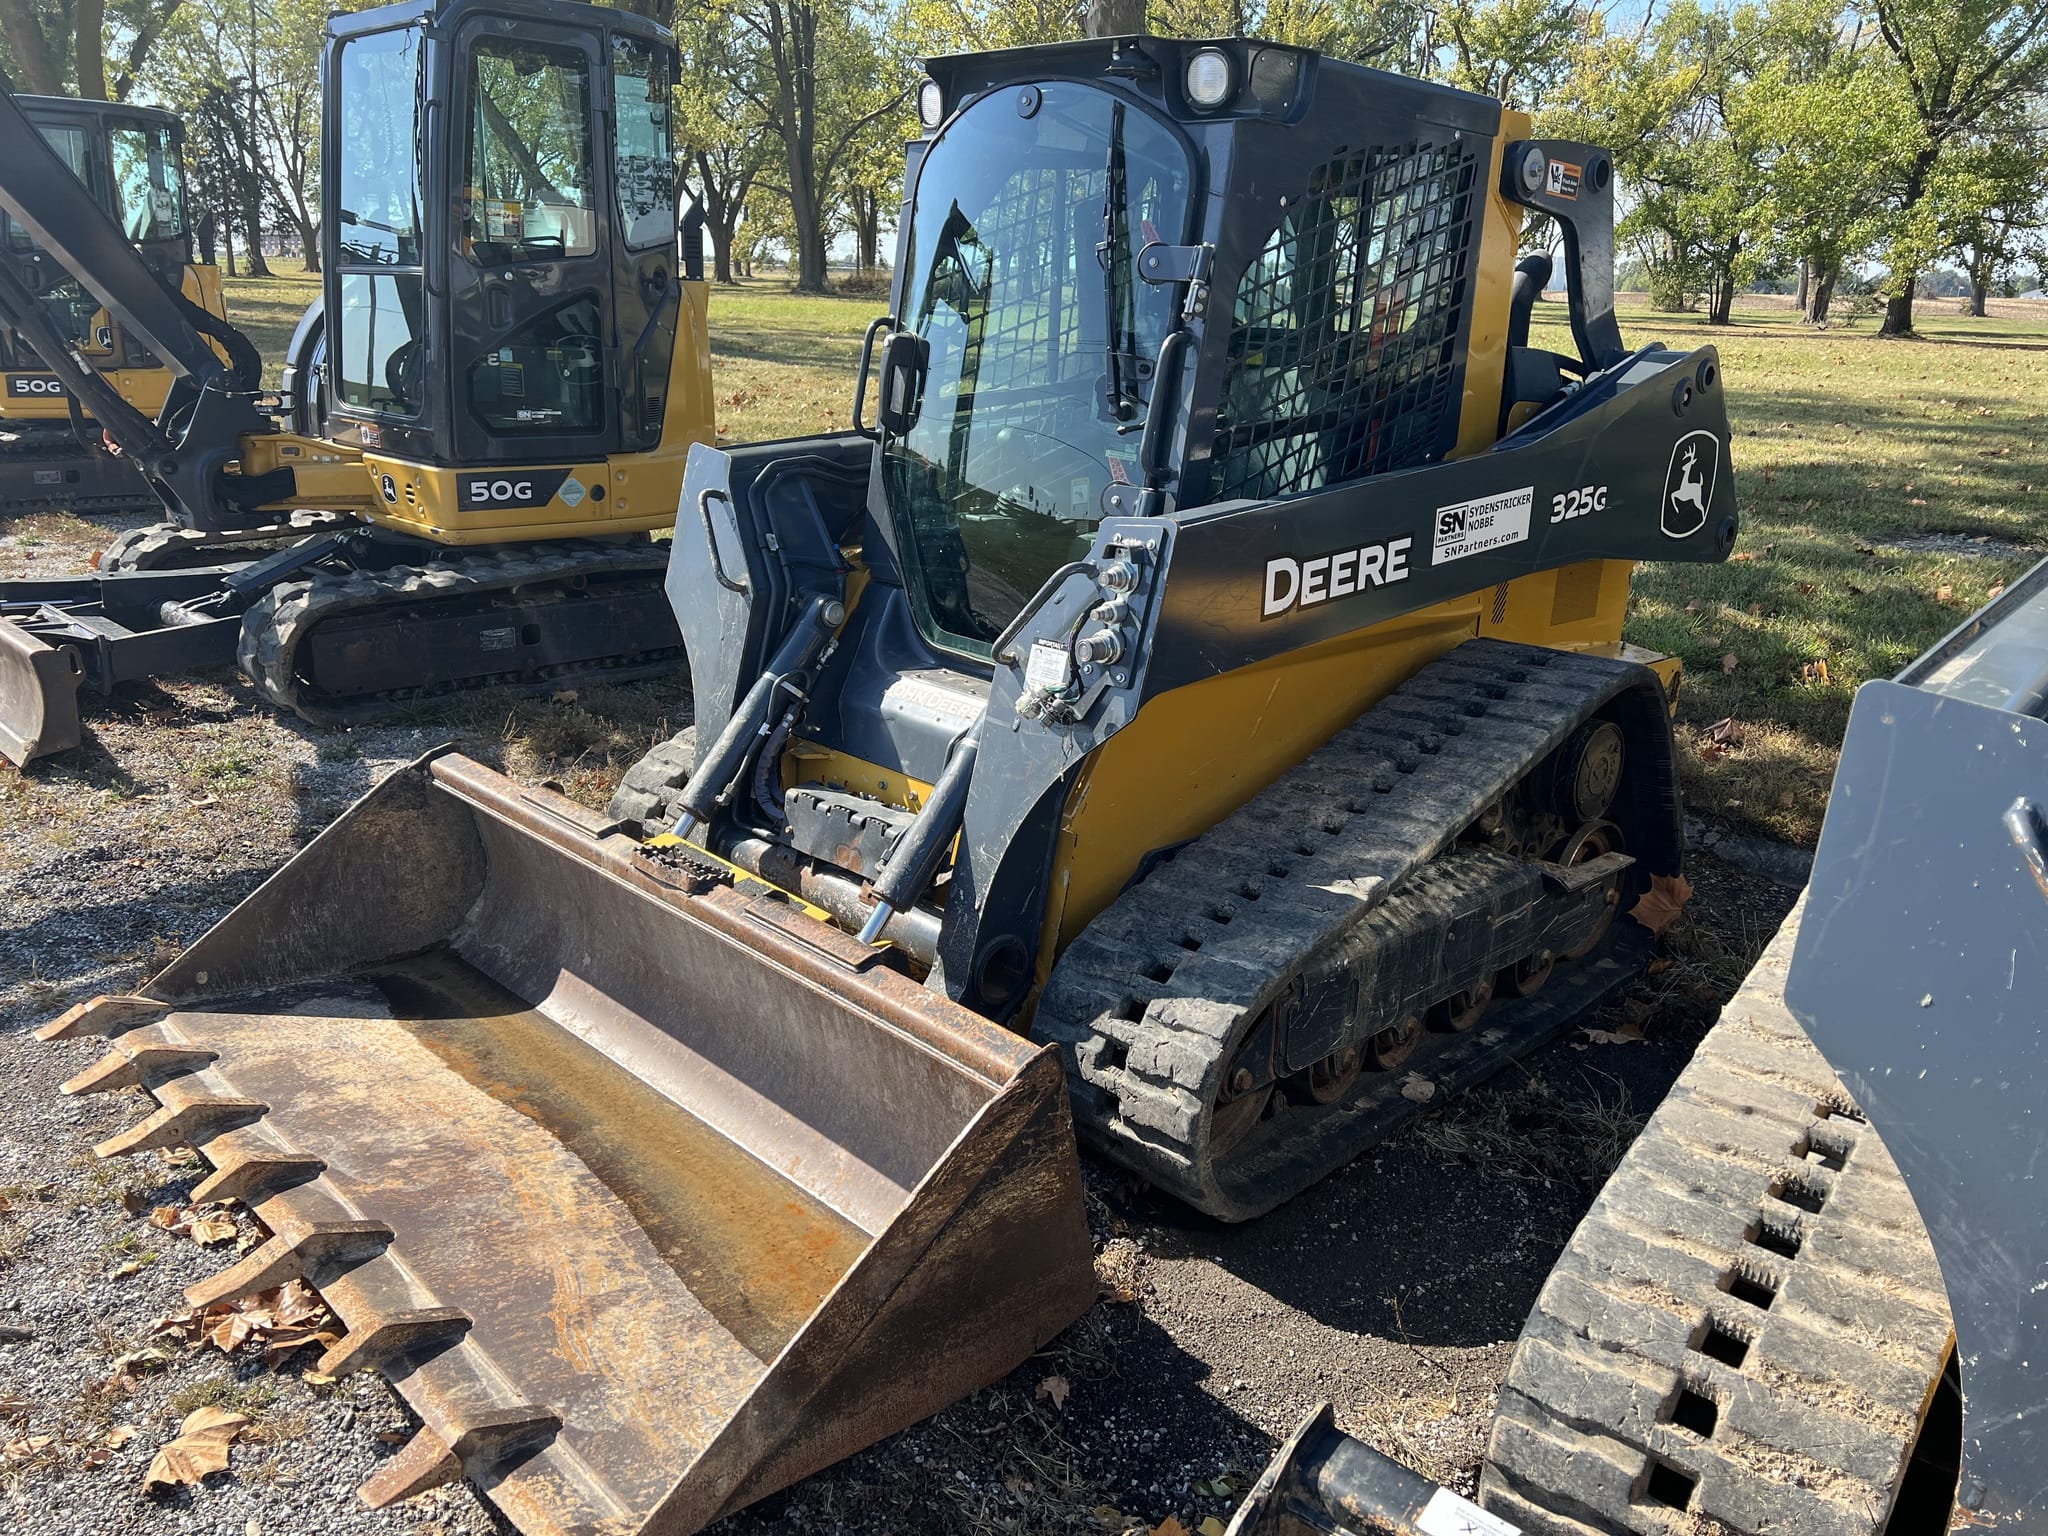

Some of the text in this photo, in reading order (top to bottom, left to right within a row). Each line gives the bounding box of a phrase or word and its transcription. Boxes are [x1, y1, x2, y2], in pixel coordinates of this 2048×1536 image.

[15, 379, 61, 393] 50G
[470, 480, 532, 502] 50G
[1469, 493, 1531, 518] SYDENSTRICKER
[1550, 485, 1607, 524] 325G
[1439, 509, 1466, 535] SN
[1468, 515, 1495, 532] NOBBE
[1438, 531, 1464, 544] PARTNERS
[1444, 531, 1519, 558] SNPartners.com
[1264, 536, 1412, 616] DEERE
[923, 691, 982, 721] DEERE
